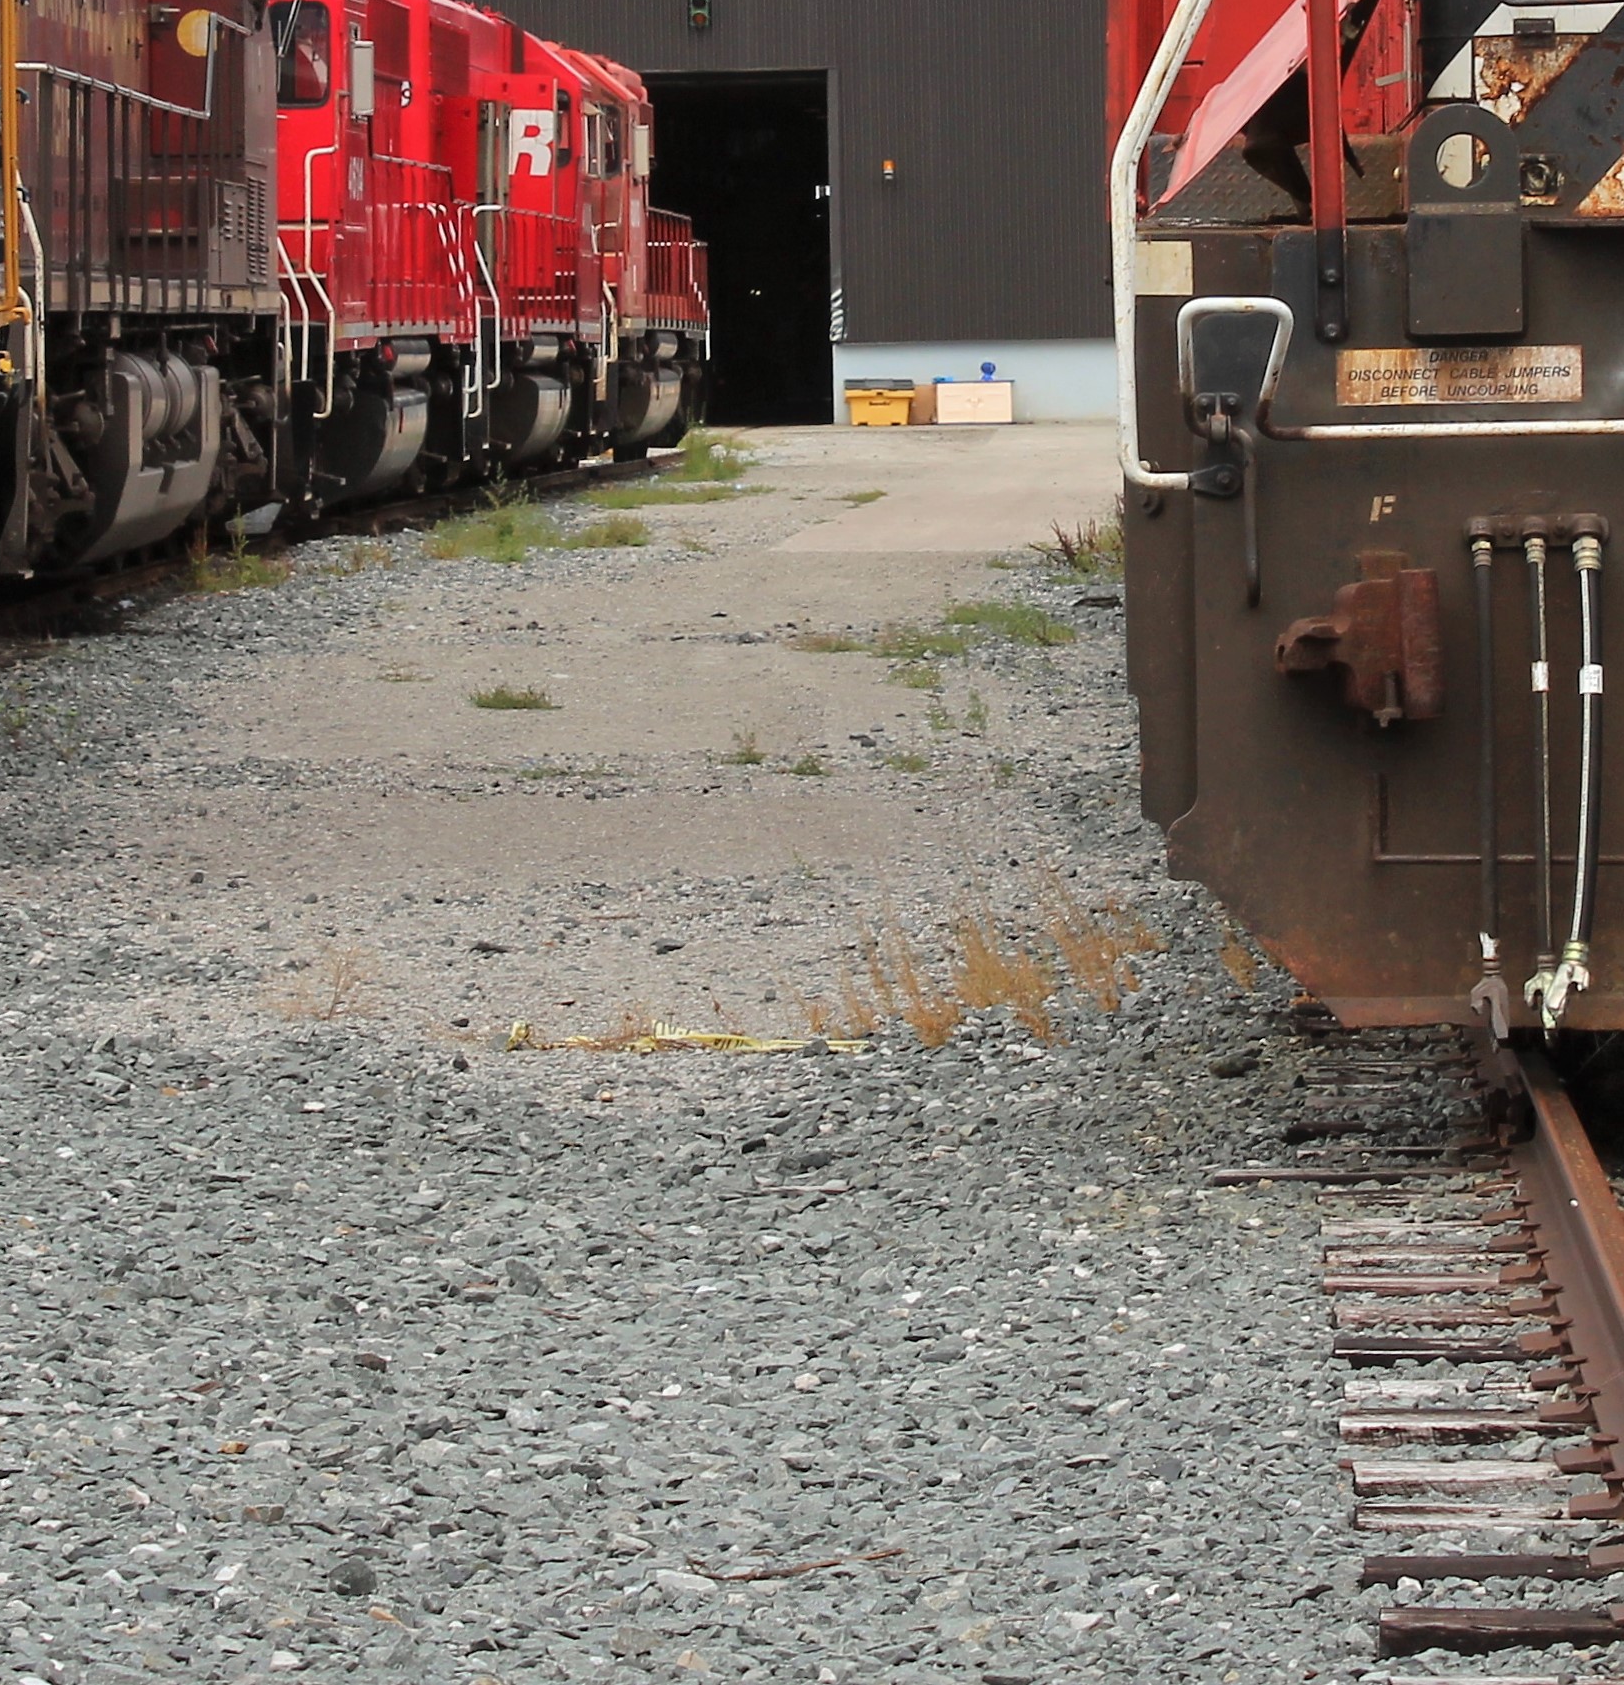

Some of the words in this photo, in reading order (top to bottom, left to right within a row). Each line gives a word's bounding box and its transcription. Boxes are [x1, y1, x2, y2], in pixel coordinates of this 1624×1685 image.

[1429, 351, 1490, 363] DANGER
[1348, 368, 1439, 381] DISCONNECT
[1450, 367, 1498, 380] CABLE
[1505, 366, 1571, 379] JUMPERS
[1381, 385, 1438, 398] BEFORE
[1447, 383, 1539, 397] UNCOUPLING
[1369, 495, 1397, 524] F
